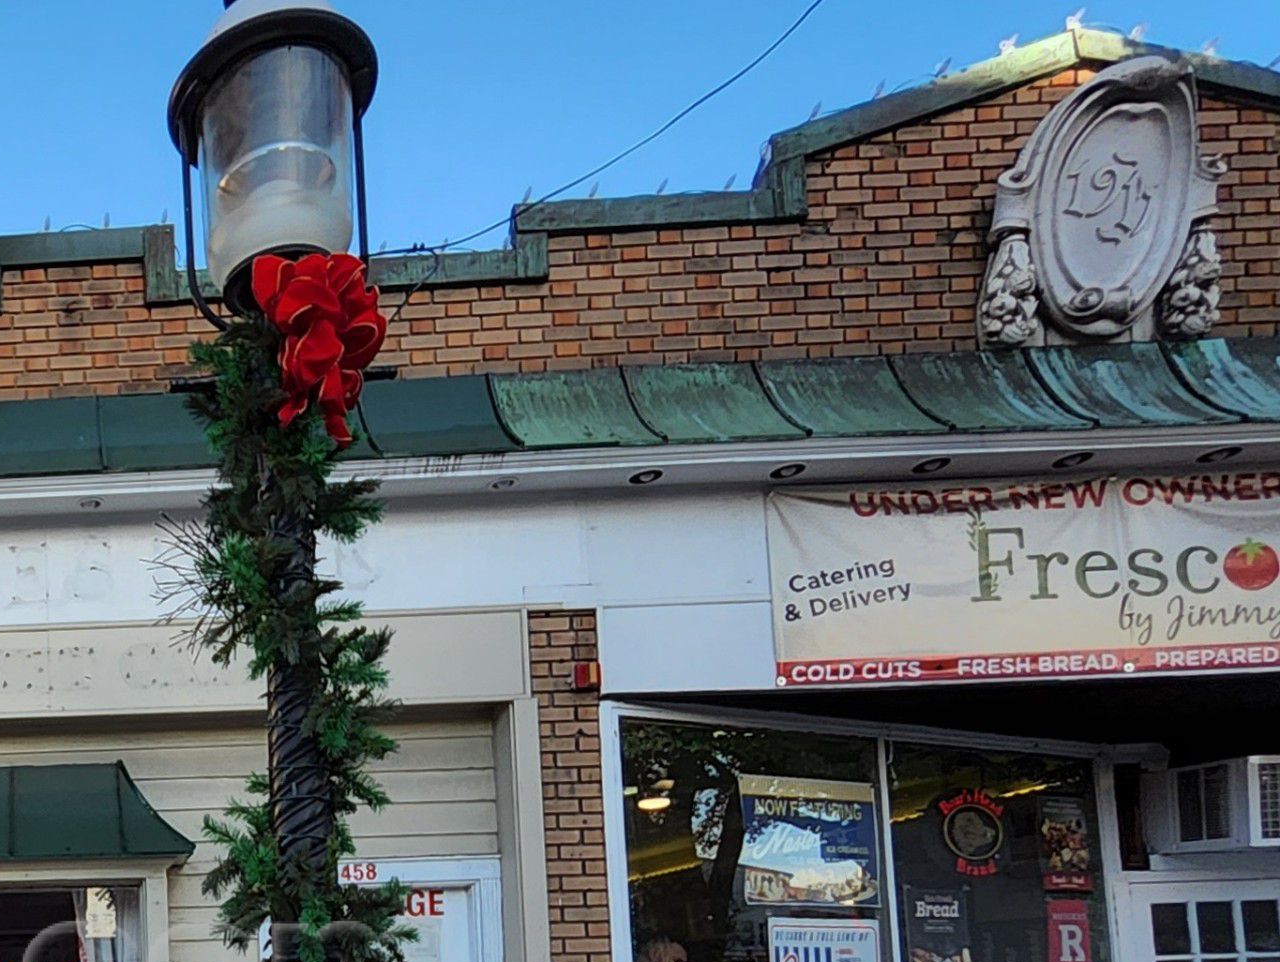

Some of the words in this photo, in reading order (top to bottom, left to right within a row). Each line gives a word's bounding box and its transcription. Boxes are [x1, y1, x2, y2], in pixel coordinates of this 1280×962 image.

[850, 486, 998, 518] UNDER
[1013, 480, 1107, 510] NEW
[1122, 472, 1280, 506] OWNER
[788, 558, 895, 593] Catering
[785, 603, 802, 622] &
[809, 582, 911, 617] Delivery
[1118, 592, 1154, 646] by
[791, 663, 855, 683] COLD
[861, 661, 922, 680] CUTS
[957, 656, 1032, 676] FRESH
[1038, 653, 1117, 673] BREAD
[1155, 646, 1279, 669] PREPARED
[754, 798, 788, 817] NOW
[790, 800, 863, 821] FEATURING
[340, 863, 378, 881] 458
[915, 900, 960, 918] Bread
[1057, 924, 1087, 962] R
